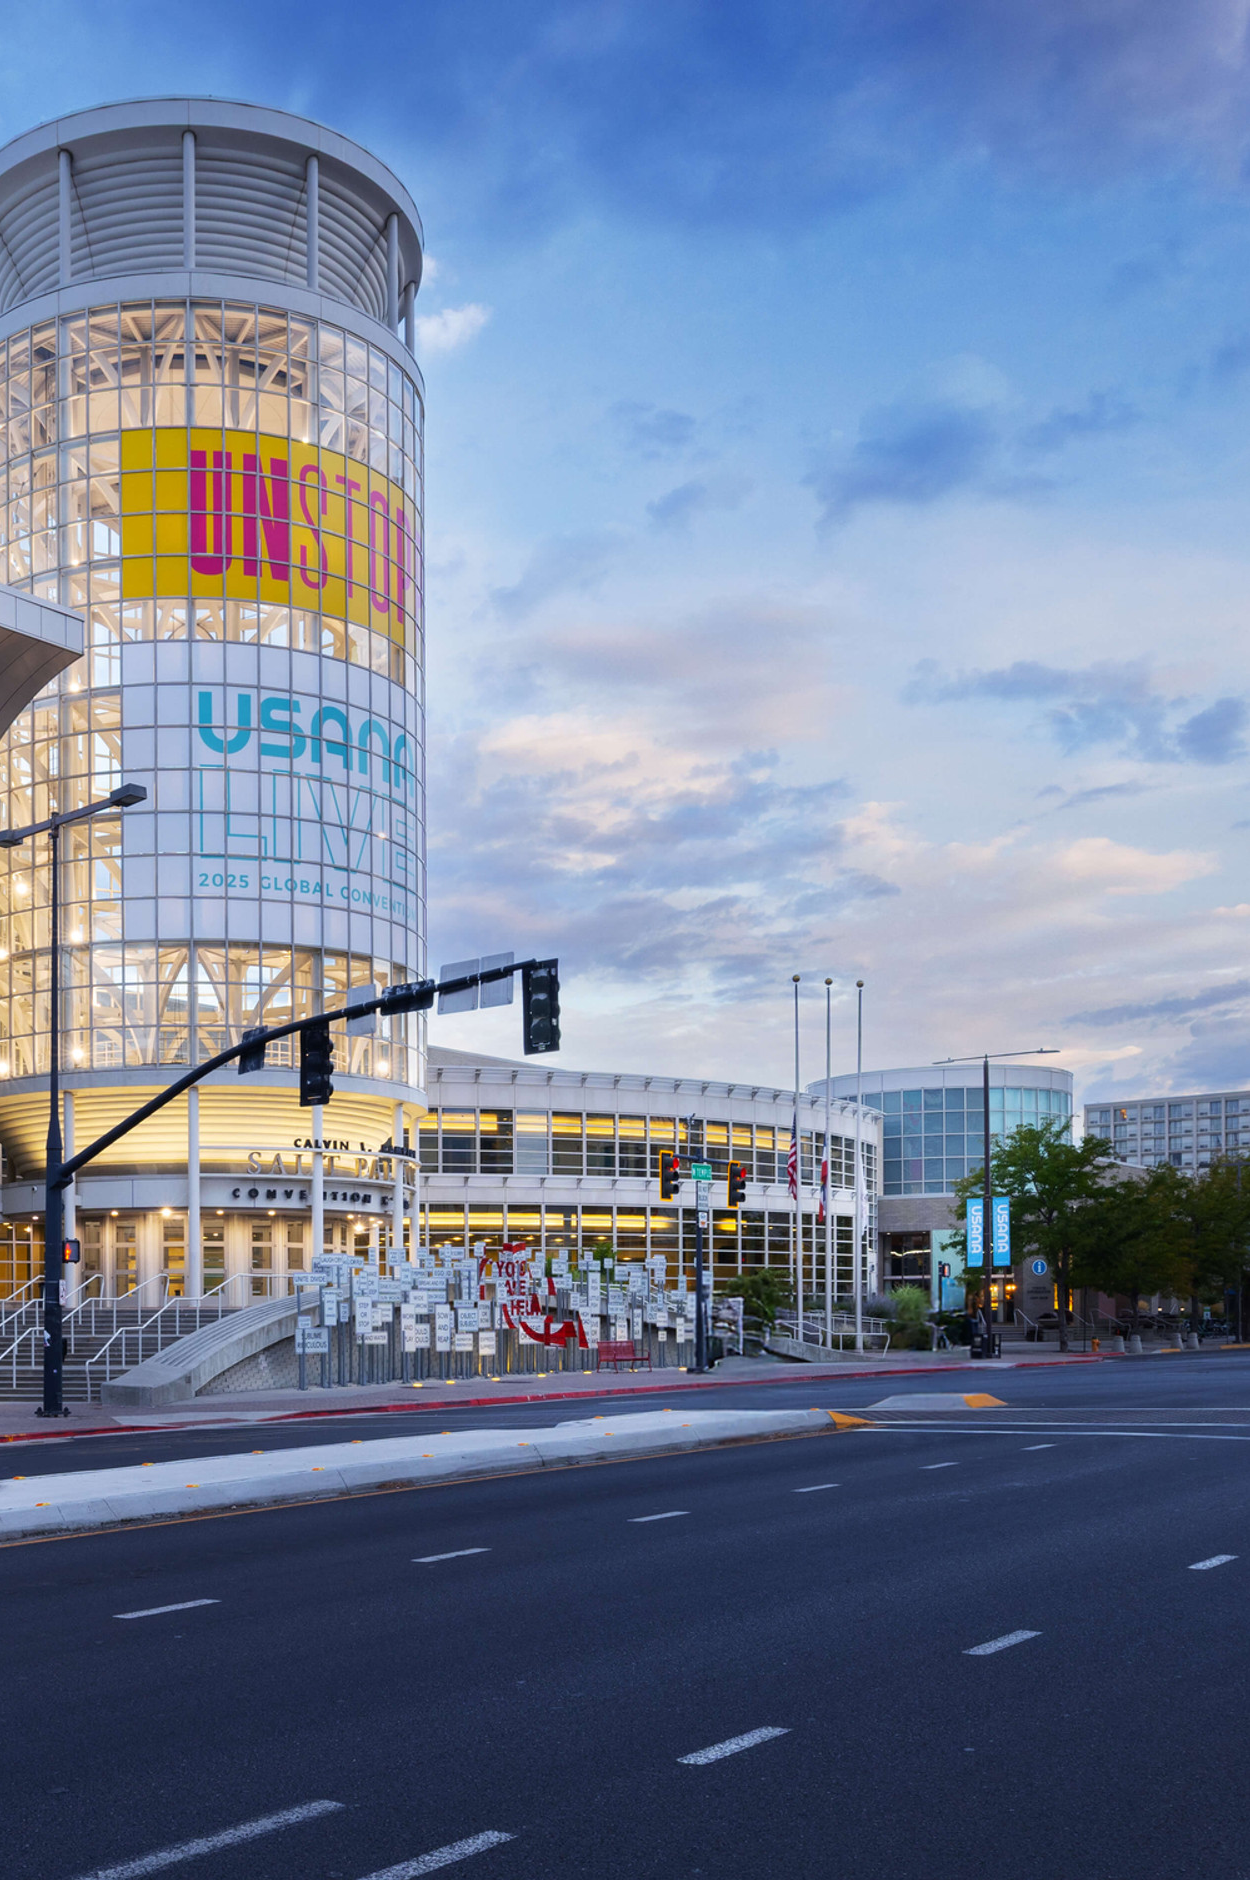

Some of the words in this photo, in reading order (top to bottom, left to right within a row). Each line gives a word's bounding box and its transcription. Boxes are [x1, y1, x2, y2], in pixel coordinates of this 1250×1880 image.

[198, 691, 415, 798] USANA
[199, 764, 415, 896] LIVE
[199, 873, 249, 888] 2025
[261, 876, 334, 897] GLOBAL
[293, 1138, 349, 1151] CALVIN
[971, 1205, 982, 1254] USANA
[997, 1204, 1009, 1253] USANA
